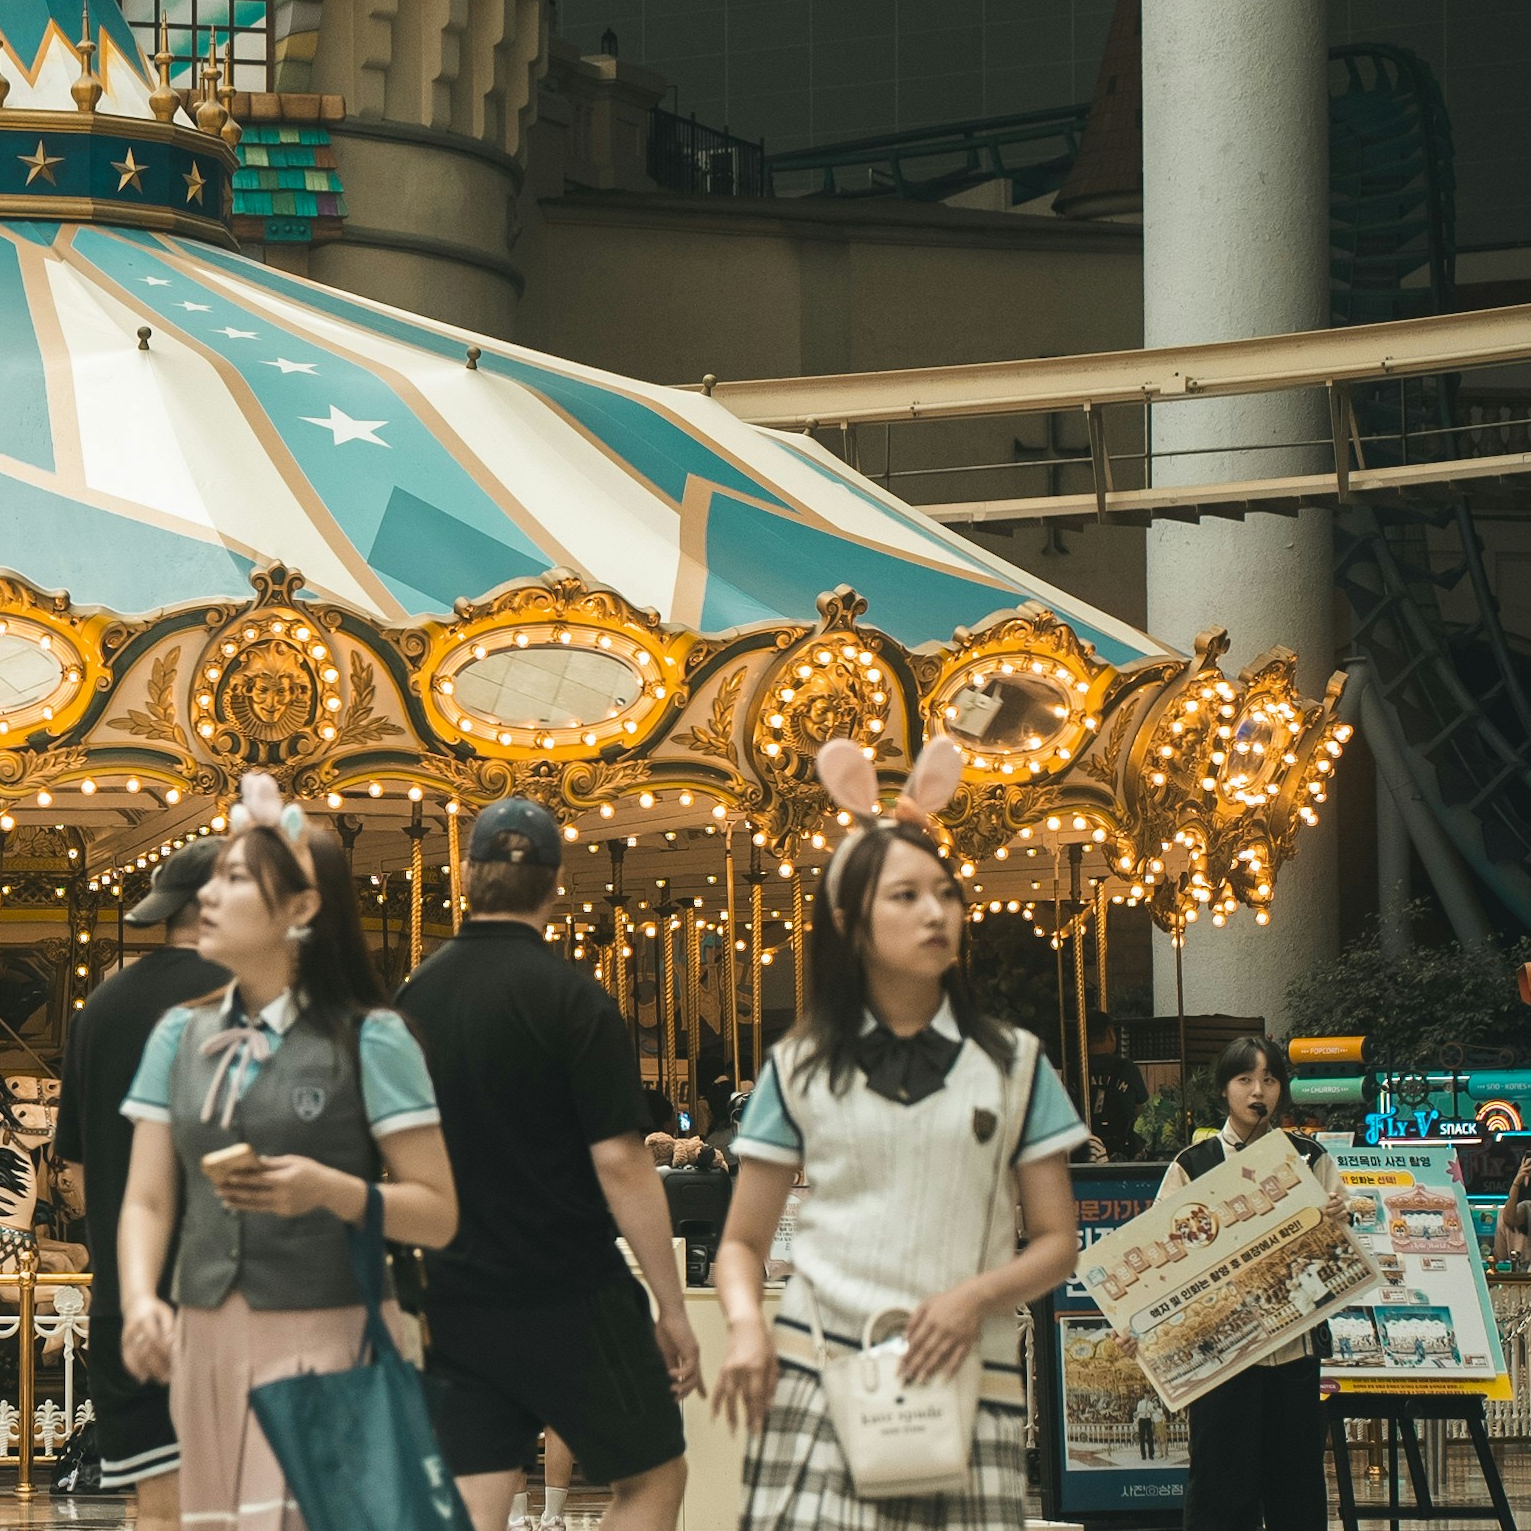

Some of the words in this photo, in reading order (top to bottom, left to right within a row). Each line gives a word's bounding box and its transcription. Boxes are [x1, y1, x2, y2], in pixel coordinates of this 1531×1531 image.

[1310, 1047, 1340, 1055] POPCORN
[1310, 1086, 1341, 1094] CHURROS
[1439, 1122, 1478, 1136] SNACK
[1337, 1155, 1381, 1167] 회전목마
[1385, 1155, 1406, 1167] 사진
[1409, 1156, 1431, 1168] 촬영
[1350, 1175, 1375, 1185] 인화는
[1377, 1175, 1397, 1185] 선택!
[1149, 1302, 1171, 1319] 액자
[1169, 1295, 1182, 1308] 및
[1181, 1279, 1211, 1301] 인화는
[1209, 1264, 1230, 1283] 촬영
[1229, 1258, 1242, 1270] 후
[1240, 1236, 1280, 1263] 매장에서
[1278, 1219, 1304, 1238] 확인!
[1121, 1484, 1146, 1498] 사진
[1158, 1483, 1184, 1497] 상점
